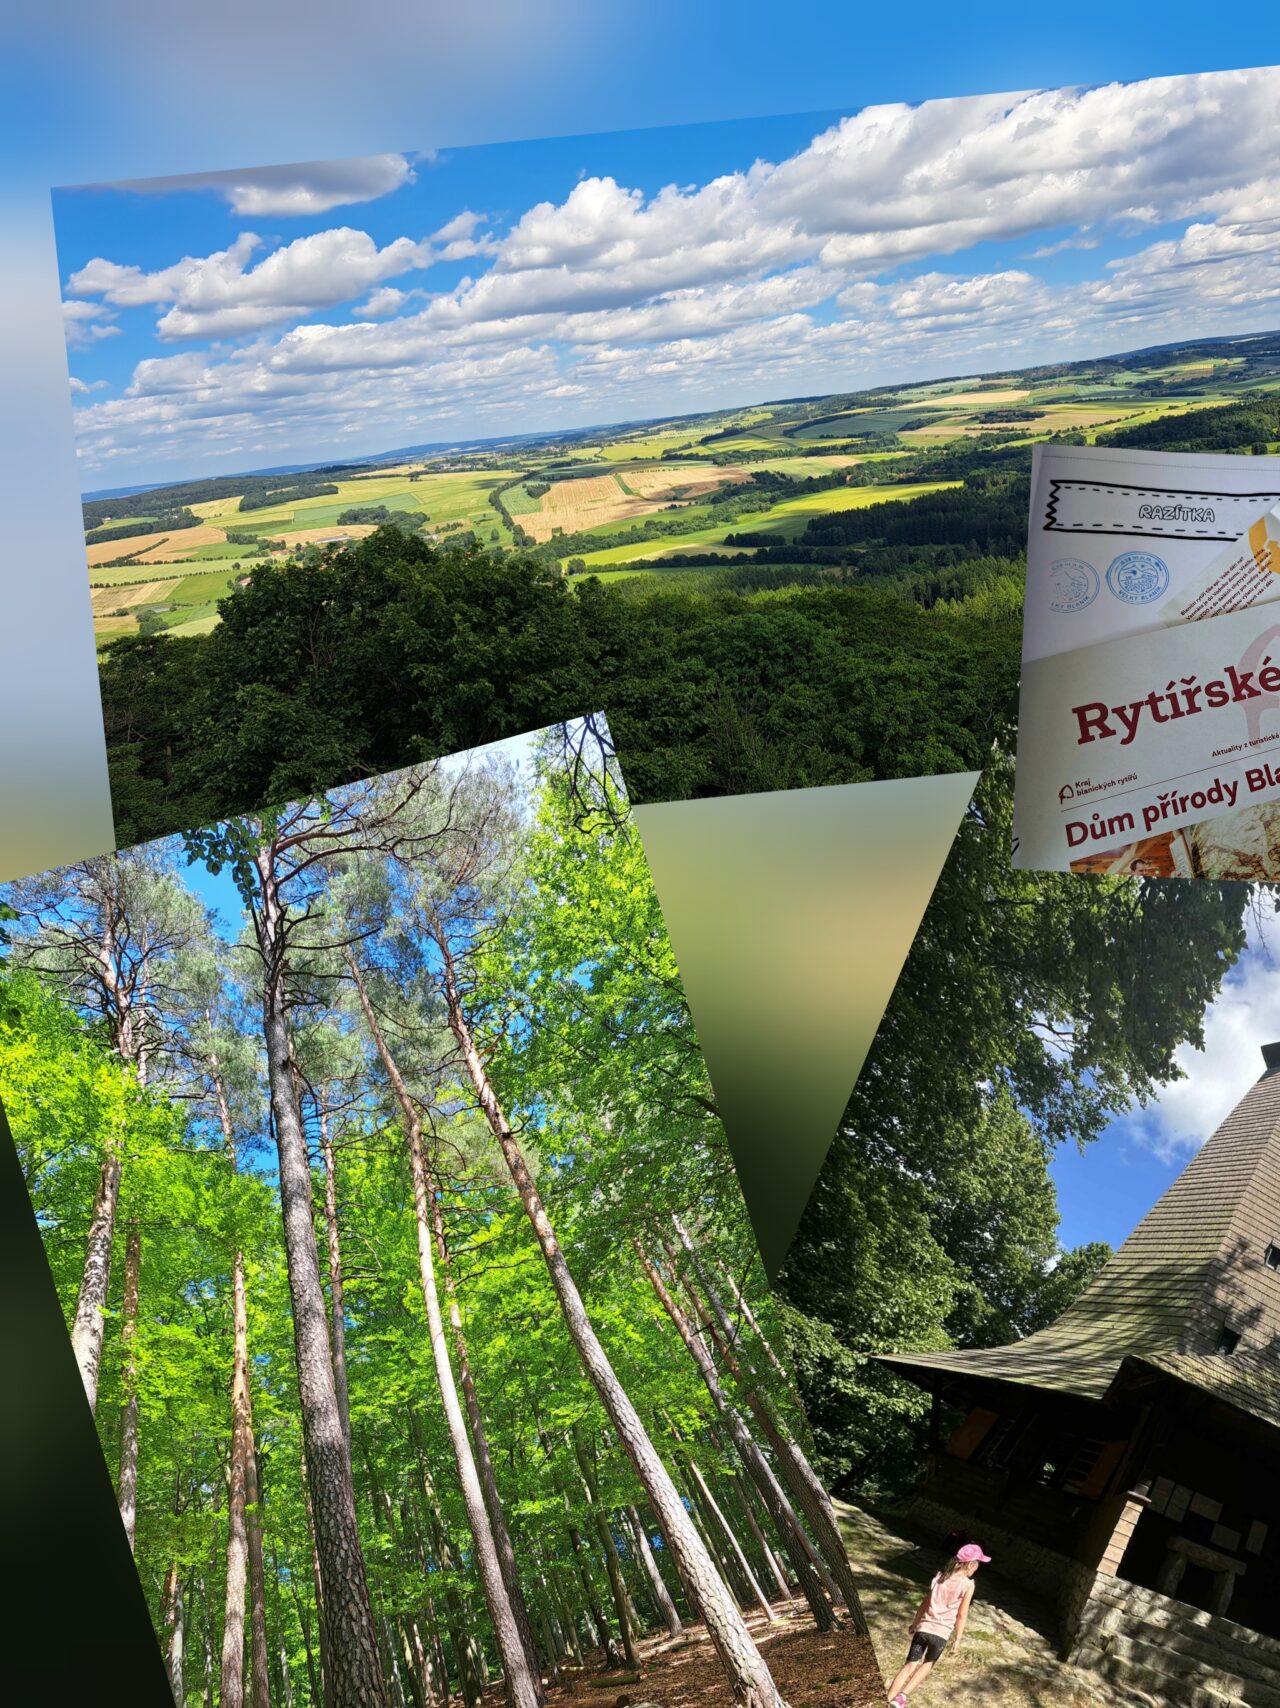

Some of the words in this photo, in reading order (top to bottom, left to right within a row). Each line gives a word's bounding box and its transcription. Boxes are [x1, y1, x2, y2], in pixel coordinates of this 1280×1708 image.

[1138, 503, 1216, 523] RAZÍTKA
[1211, 744, 1243, 757] Aktuality
[1248, 732, 1280, 747] turistické
[1075, 778, 1091, 789] Kraj
[1075, 780, 1117, 797] blanických
[1117, 772, 1138, 786] rytířů
[1065, 812, 1135, 848] Dům
[1142, 778, 1238, 832] přírody
